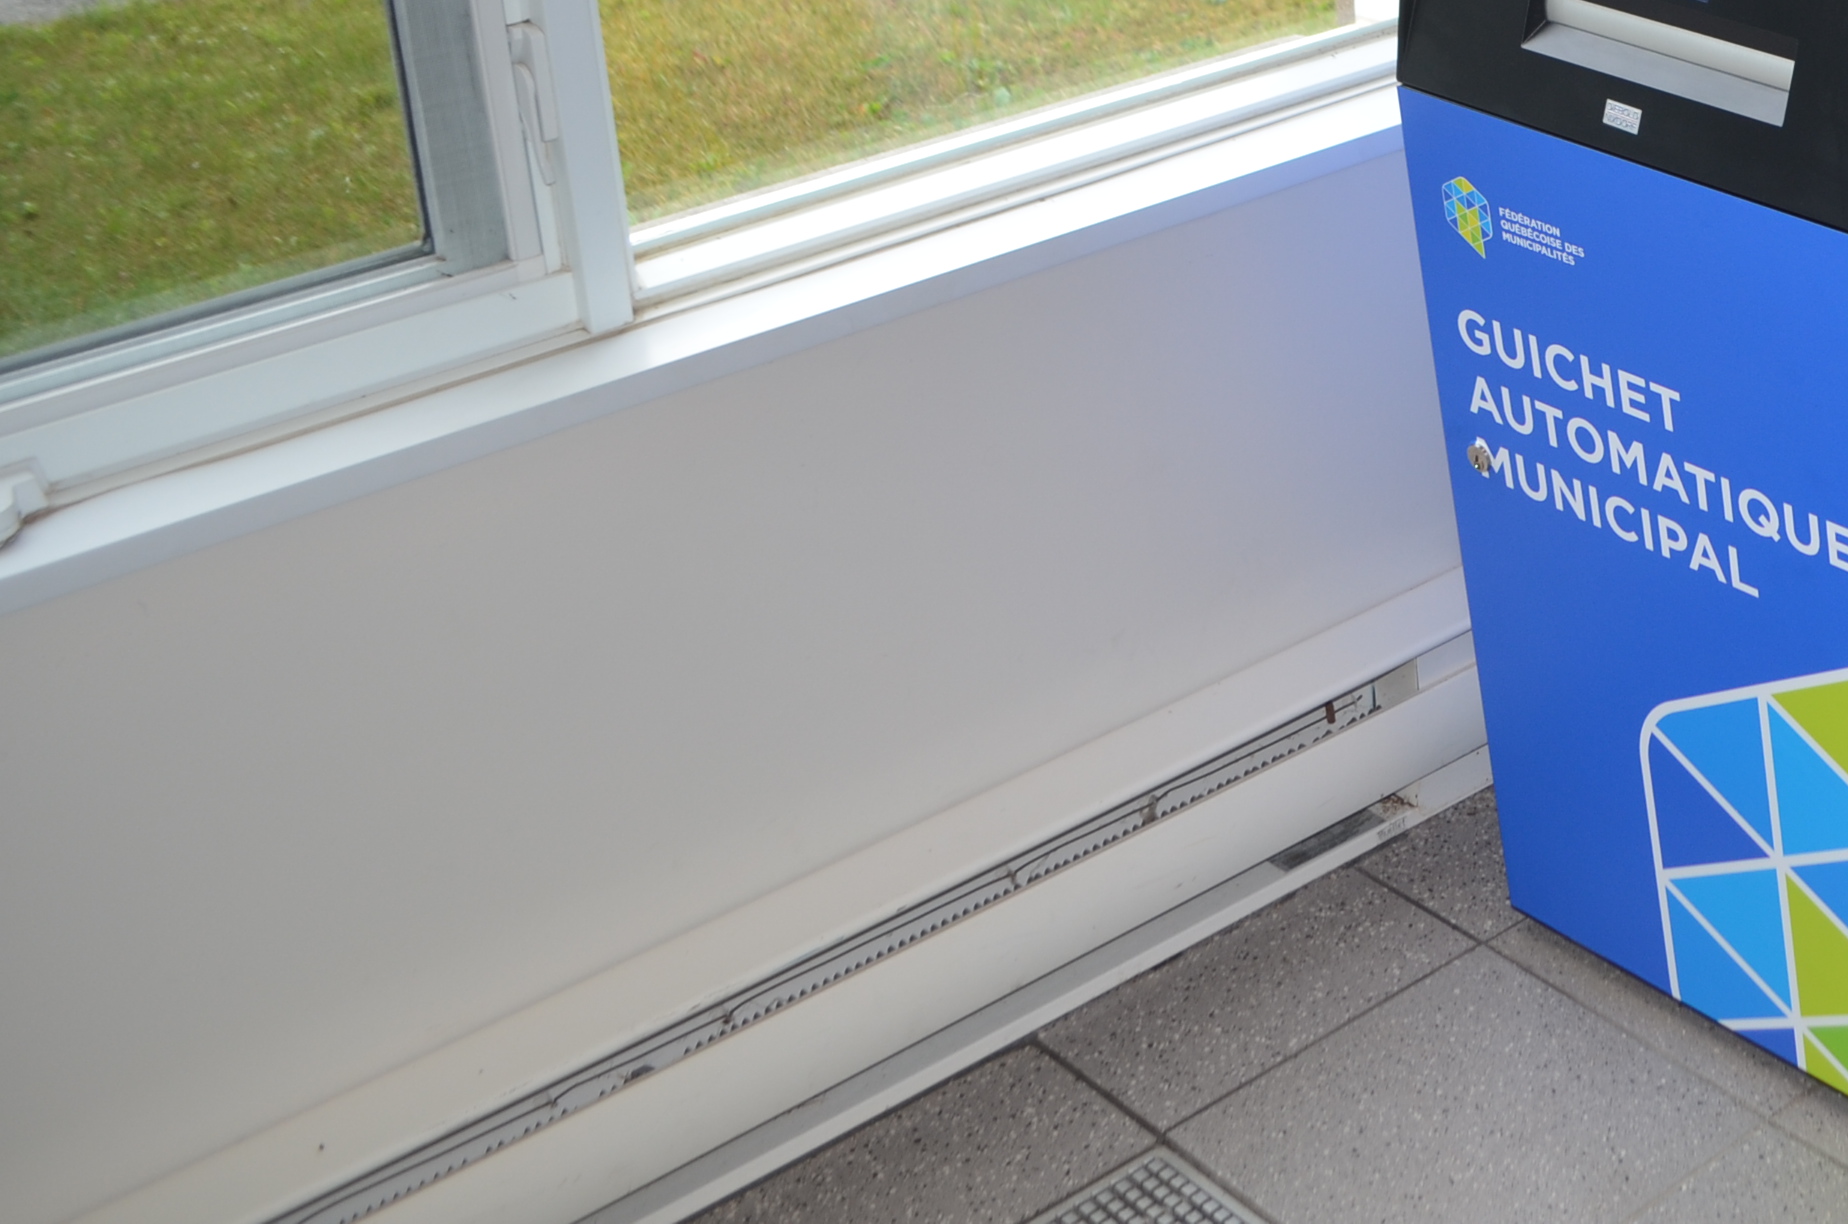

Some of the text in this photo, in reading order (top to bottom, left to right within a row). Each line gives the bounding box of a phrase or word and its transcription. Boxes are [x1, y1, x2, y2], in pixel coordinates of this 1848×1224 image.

[1499, 206, 1561, 237] FÉDÉRATION
[1500, 219, 1585, 258] QUÉBÉCOISE DES
[1502, 231, 1576, 266] MUNICIPALITÉS
[1457, 309, 1681, 433] GUICHET
[1475, 436, 1760, 599] MUNICIPAL
